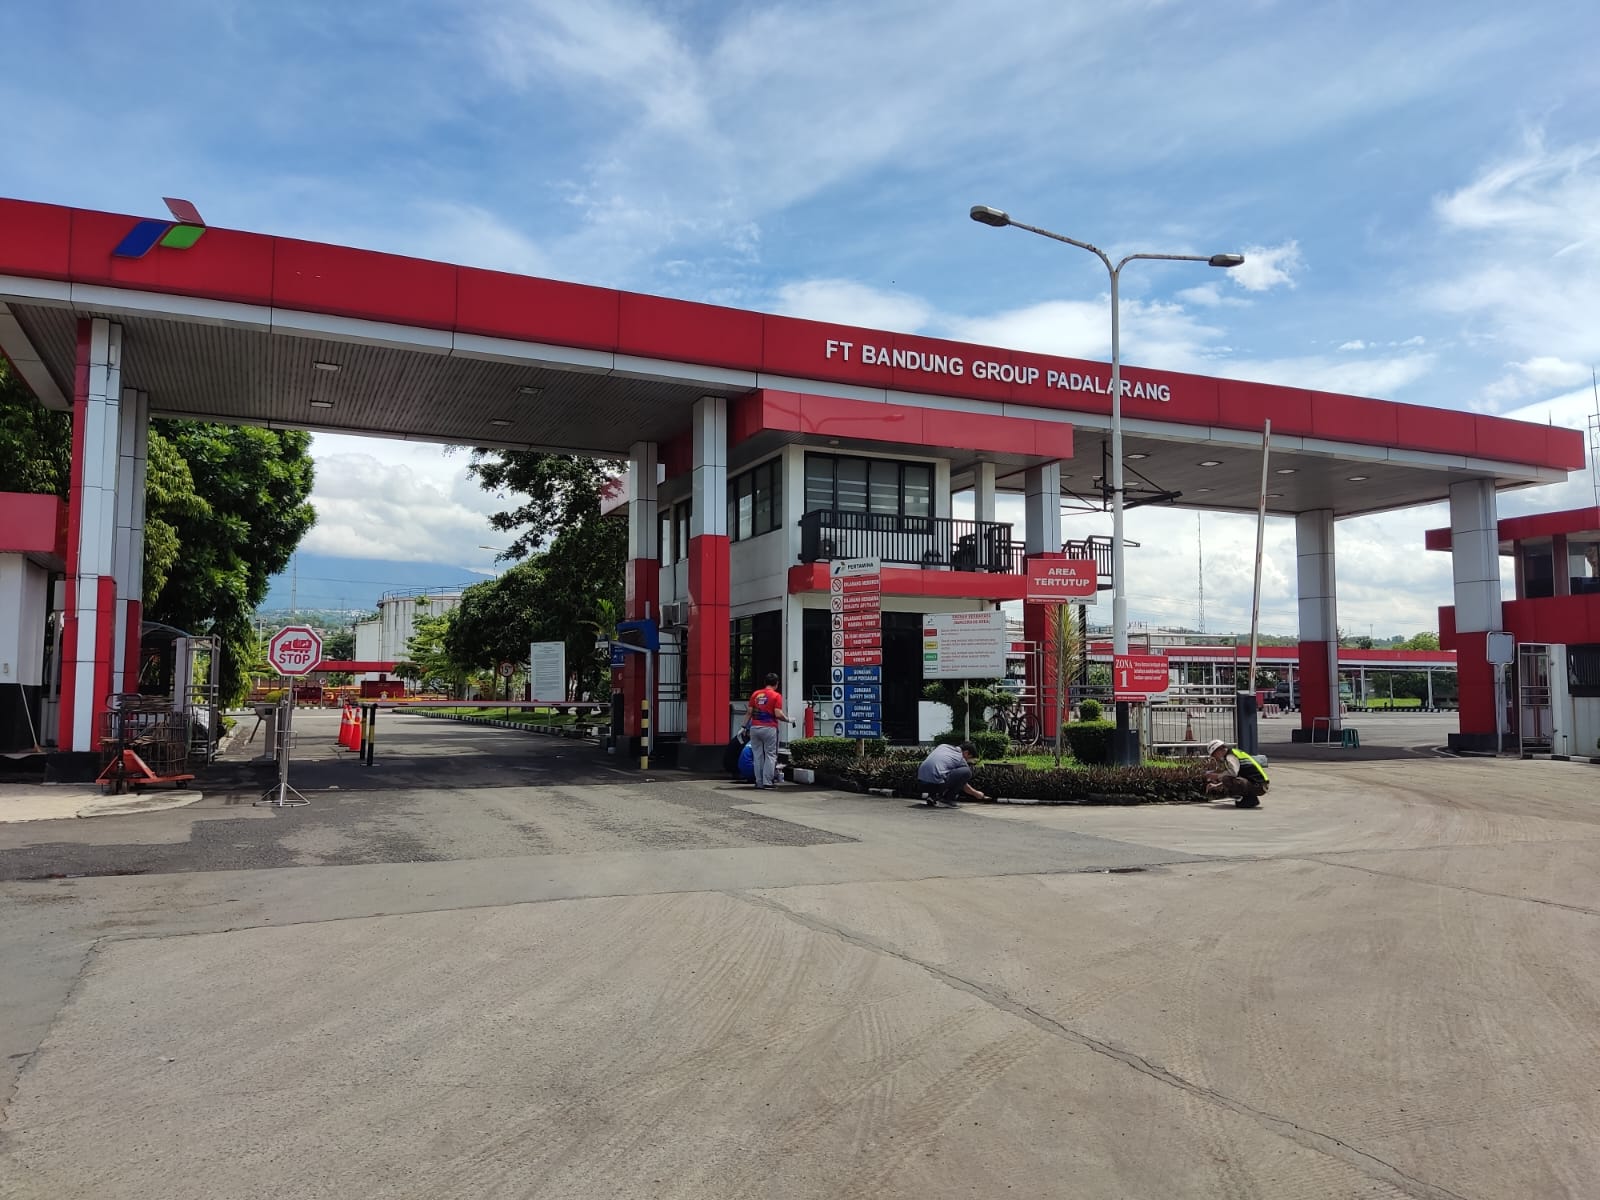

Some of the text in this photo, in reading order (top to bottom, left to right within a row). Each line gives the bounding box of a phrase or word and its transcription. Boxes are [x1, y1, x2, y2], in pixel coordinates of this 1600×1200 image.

[825, 339, 1171, 402] FT BANDUNG GROUP PADALARANG
[848, 562, 874, 570] PERTAMINA
[1048, 567, 1076, 576] AREA
[1034, 578, 1090, 587] TERTUTUP
[279, 653, 310, 664] STOP
[1115, 658, 1133, 669] ZONA
[1119, 670, 1129, 688] 1
